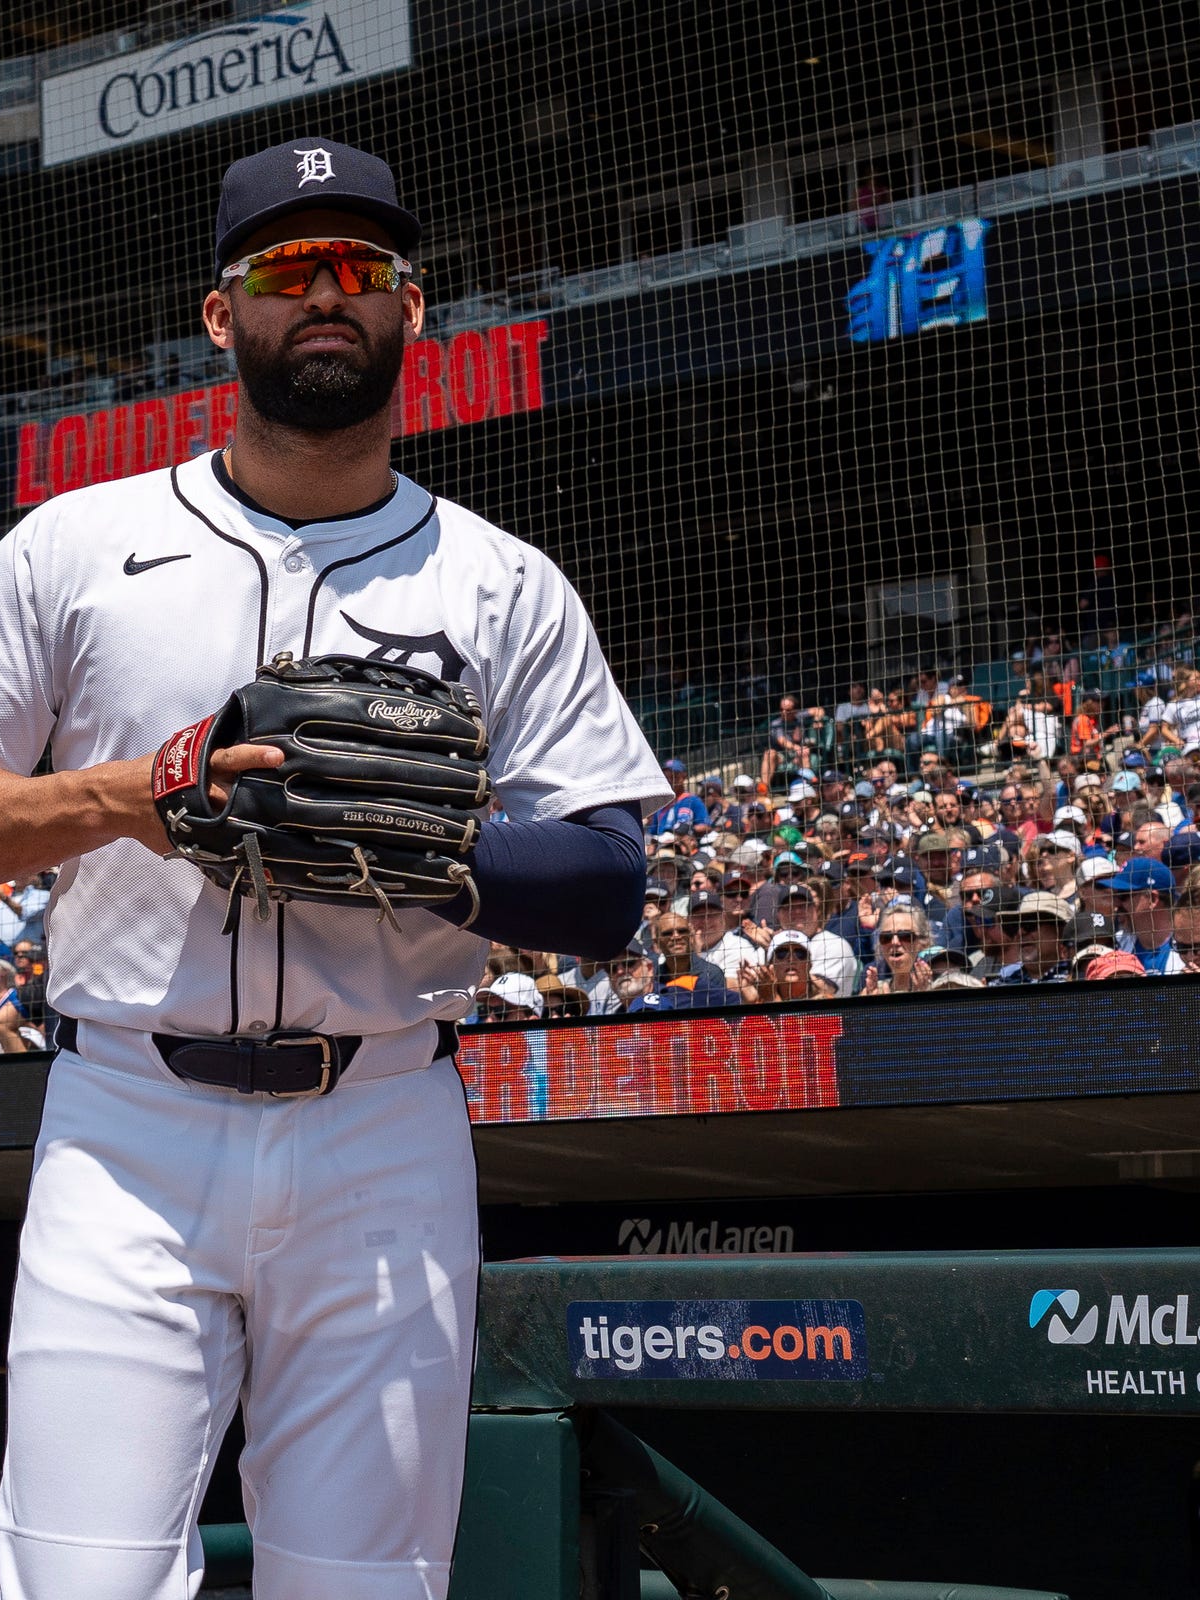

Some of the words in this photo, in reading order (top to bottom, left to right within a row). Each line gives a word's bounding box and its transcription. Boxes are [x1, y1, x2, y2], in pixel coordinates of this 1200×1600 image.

[293, 147, 336, 188] D
[402, 320, 549, 435] ROIT
[367, 699, 442, 727] Rawlings
[168, 728, 197, 783] Rawlings
[343, 810, 365, 821] THE
[365, 812, 394, 825] GOLD
[394, 818, 430, 833] GLOVE
[429, 823, 447, 836] CO.
[546, 1014, 844, 1119] DETROIT
[666, 1220, 794, 1254] McLaren
[1105, 1294, 1200, 1345] McL
[579, 1315, 853, 1371] tigers.com
[1086, 1369, 1187, 1395] HEALTH
